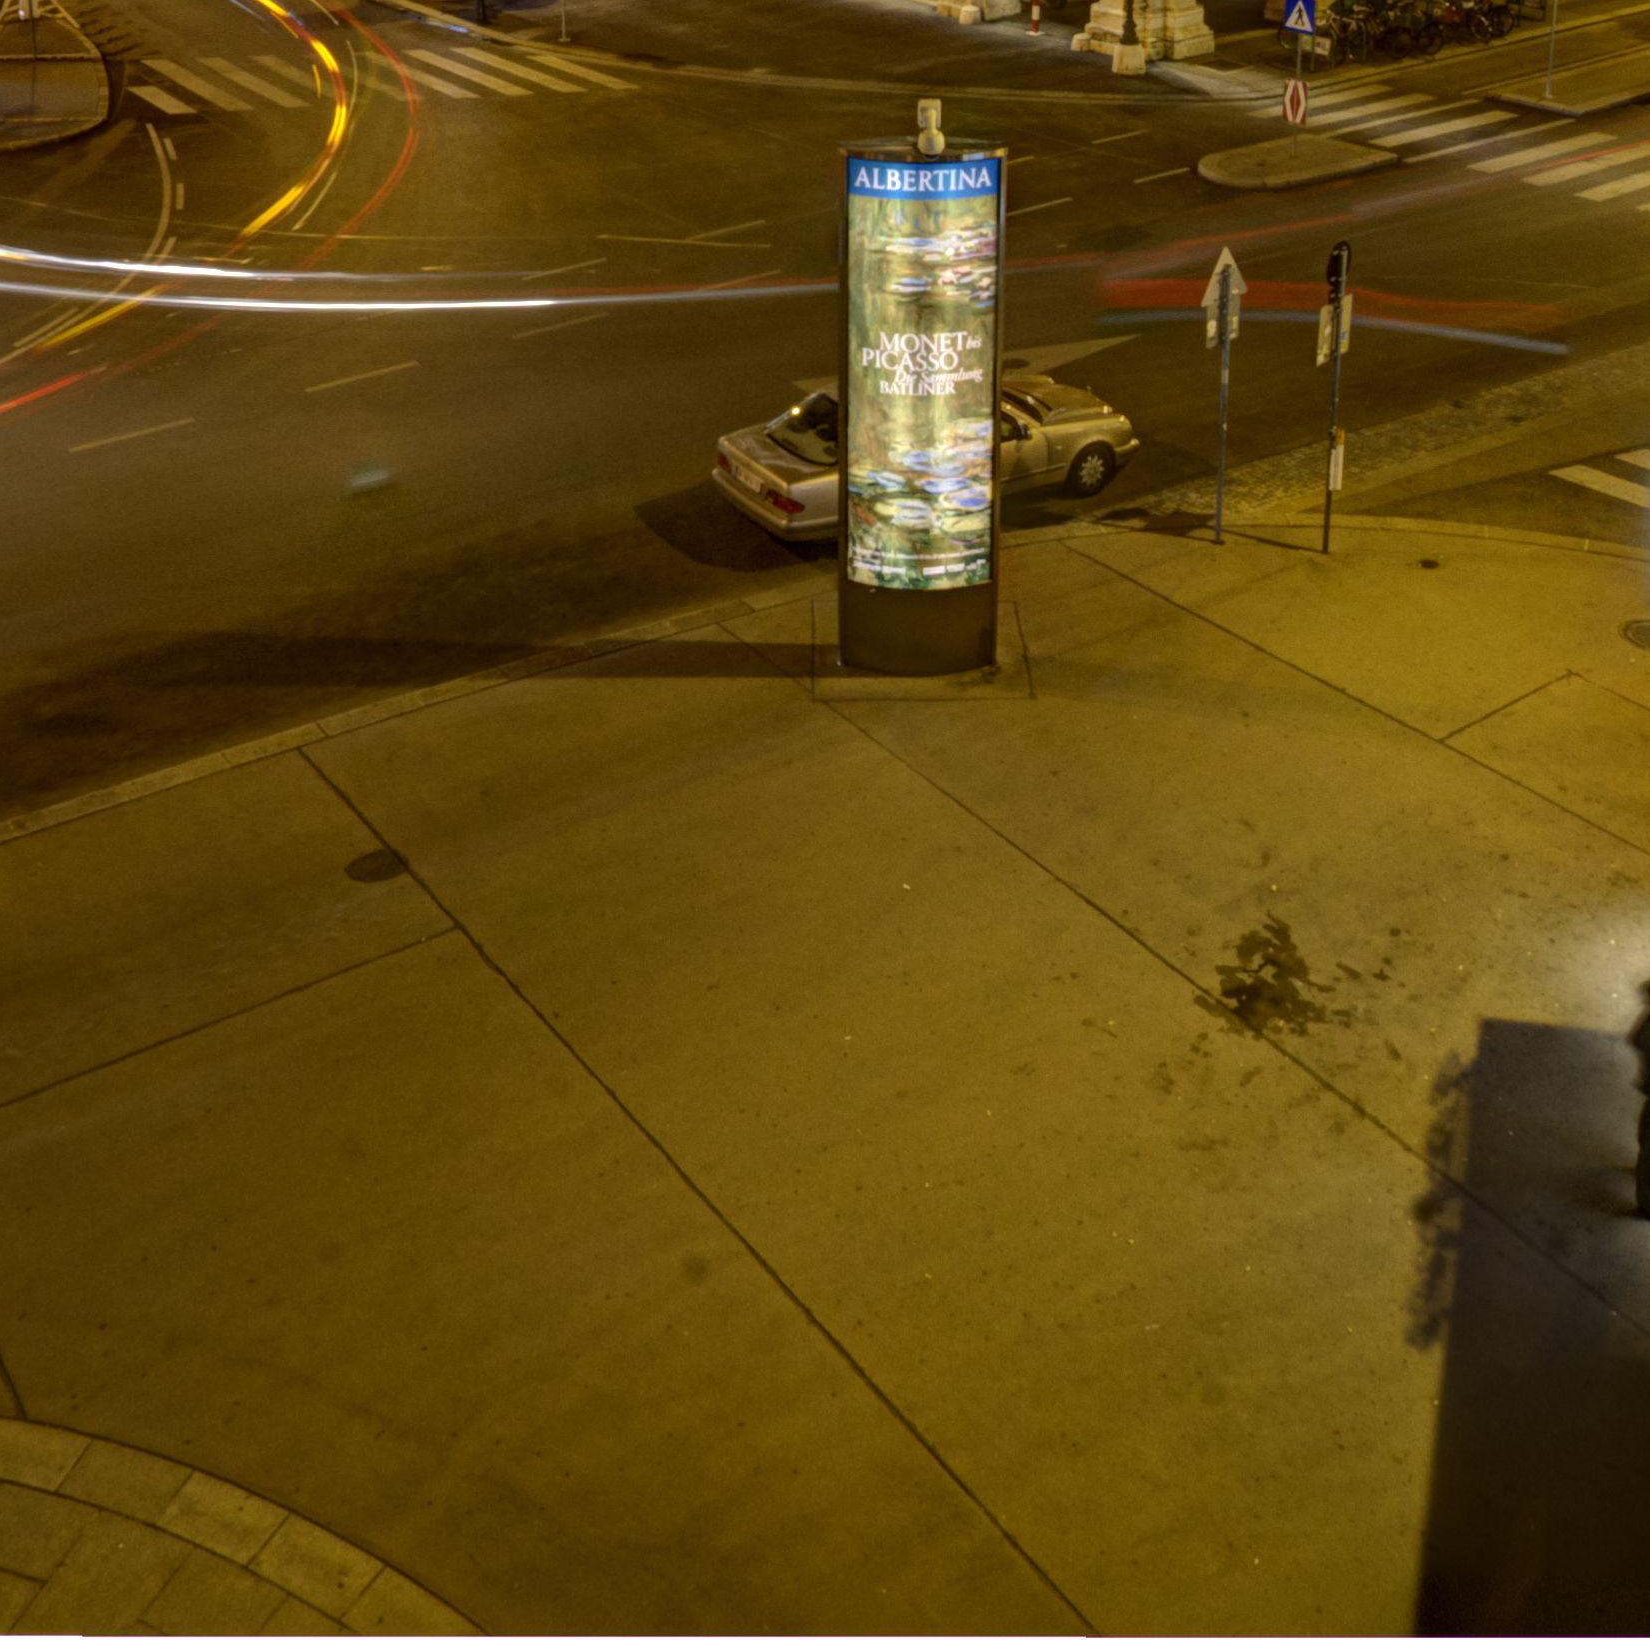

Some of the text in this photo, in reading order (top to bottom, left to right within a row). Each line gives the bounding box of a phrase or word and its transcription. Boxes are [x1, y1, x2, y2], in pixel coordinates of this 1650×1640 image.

[854, 166, 992, 192] ALBERTINA
[880, 331, 968, 352] MONET
[862, 347, 959, 371] PICASSO
[921, 367, 983, 383] Sammlung
[879, 380, 956, 396] BATLINER
